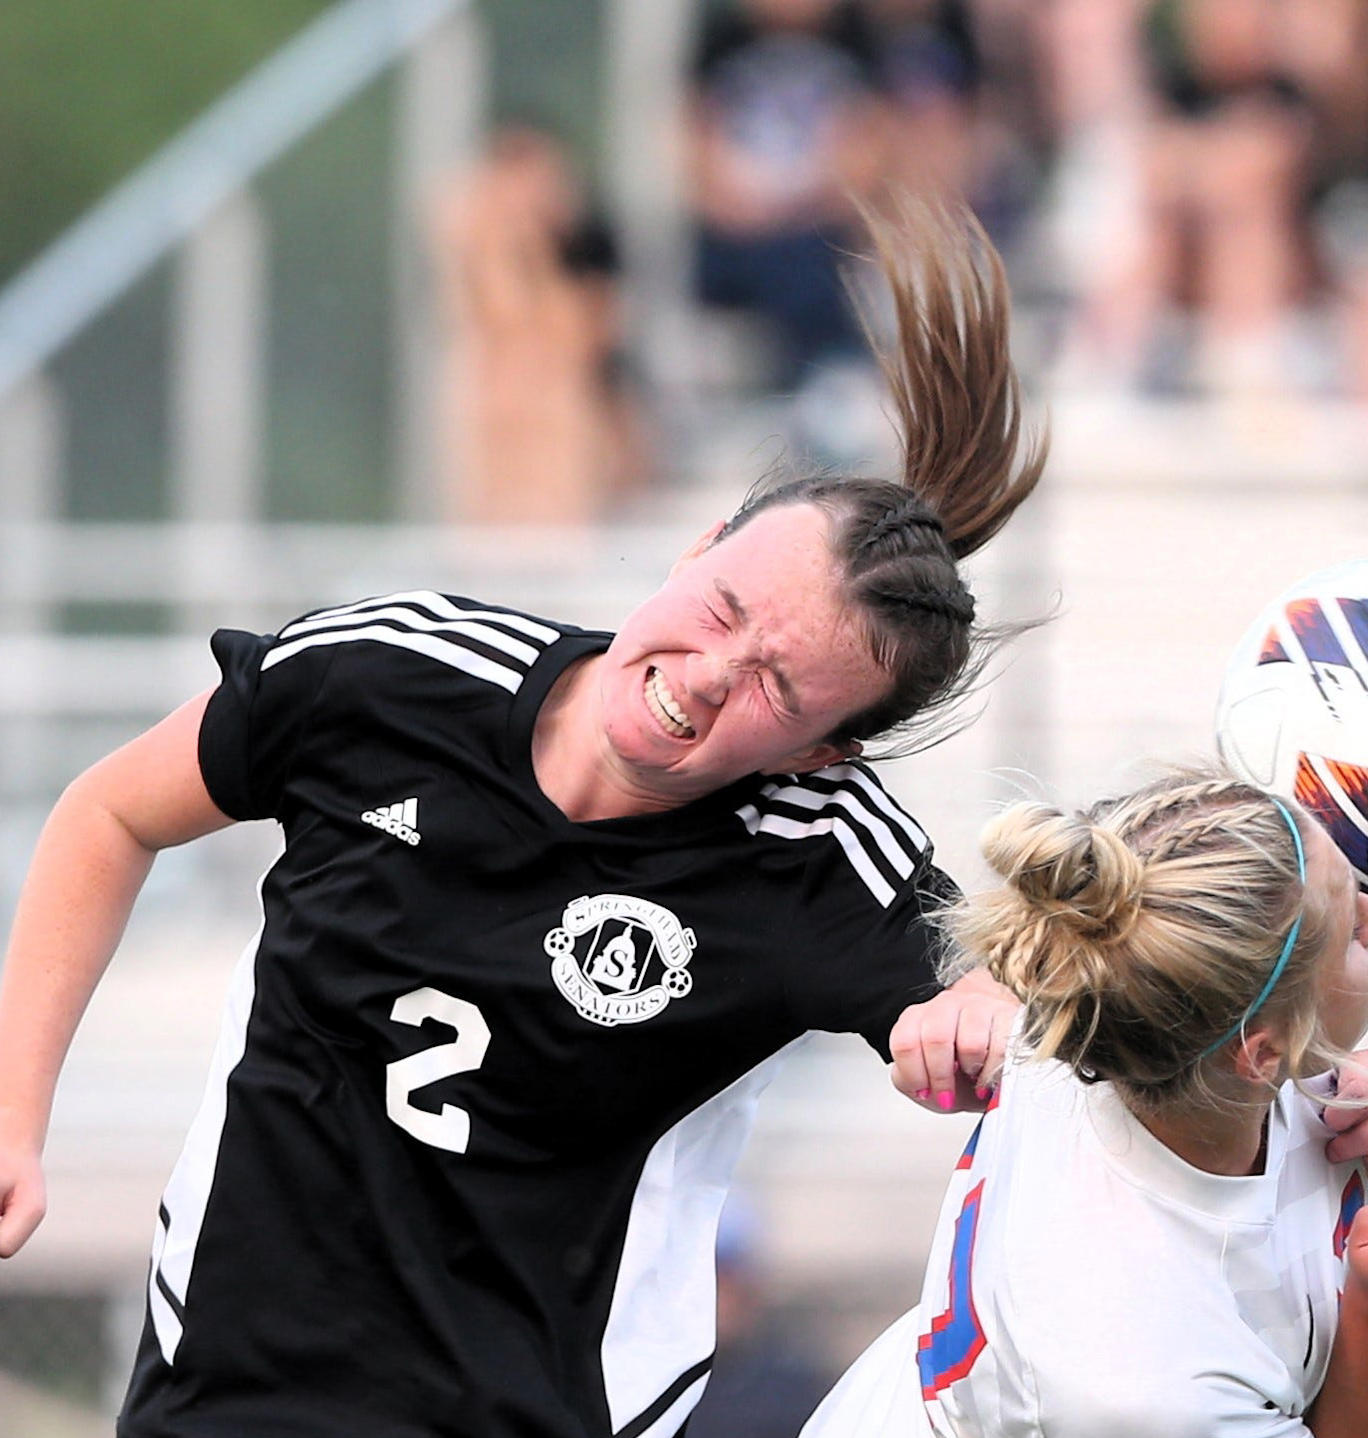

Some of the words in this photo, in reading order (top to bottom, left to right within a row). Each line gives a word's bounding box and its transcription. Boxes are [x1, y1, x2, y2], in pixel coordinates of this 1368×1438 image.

[361, 811, 421, 846] adidas
[604, 949, 628, 977] S
[559, 963, 661, 1015] SENATORS
[386, 987, 491, 1154] 2
